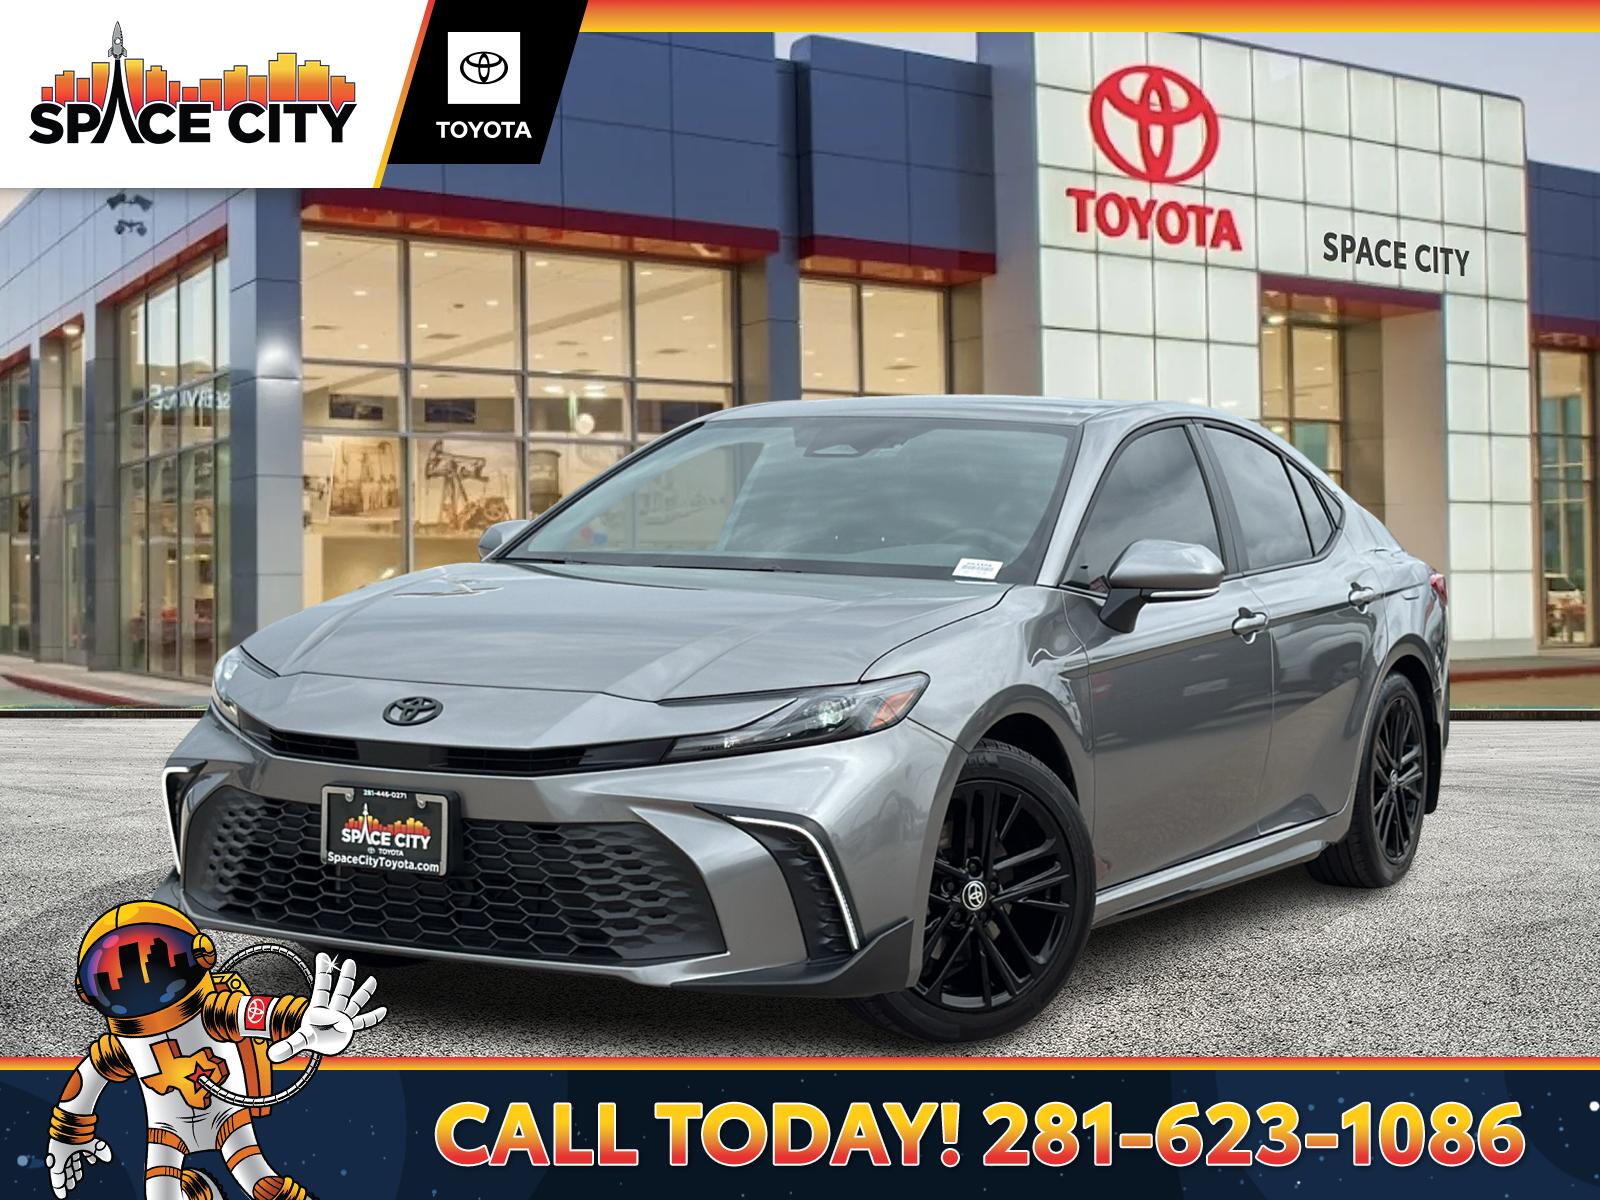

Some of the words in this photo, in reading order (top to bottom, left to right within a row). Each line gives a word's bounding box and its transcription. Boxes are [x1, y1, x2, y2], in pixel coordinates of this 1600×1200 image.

[1066, 187, 1243, 252] TOYOTA
[1323, 231, 1408, 270] SPACE
[1414, 244, 1471, 277] CITY
[341, 816, 391, 847] SPACE
[394, 832, 431, 850] CITY
[327, 851, 439, 872] SpaceCityToyota.com
[378, 847, 404, 857] TOYOTA
